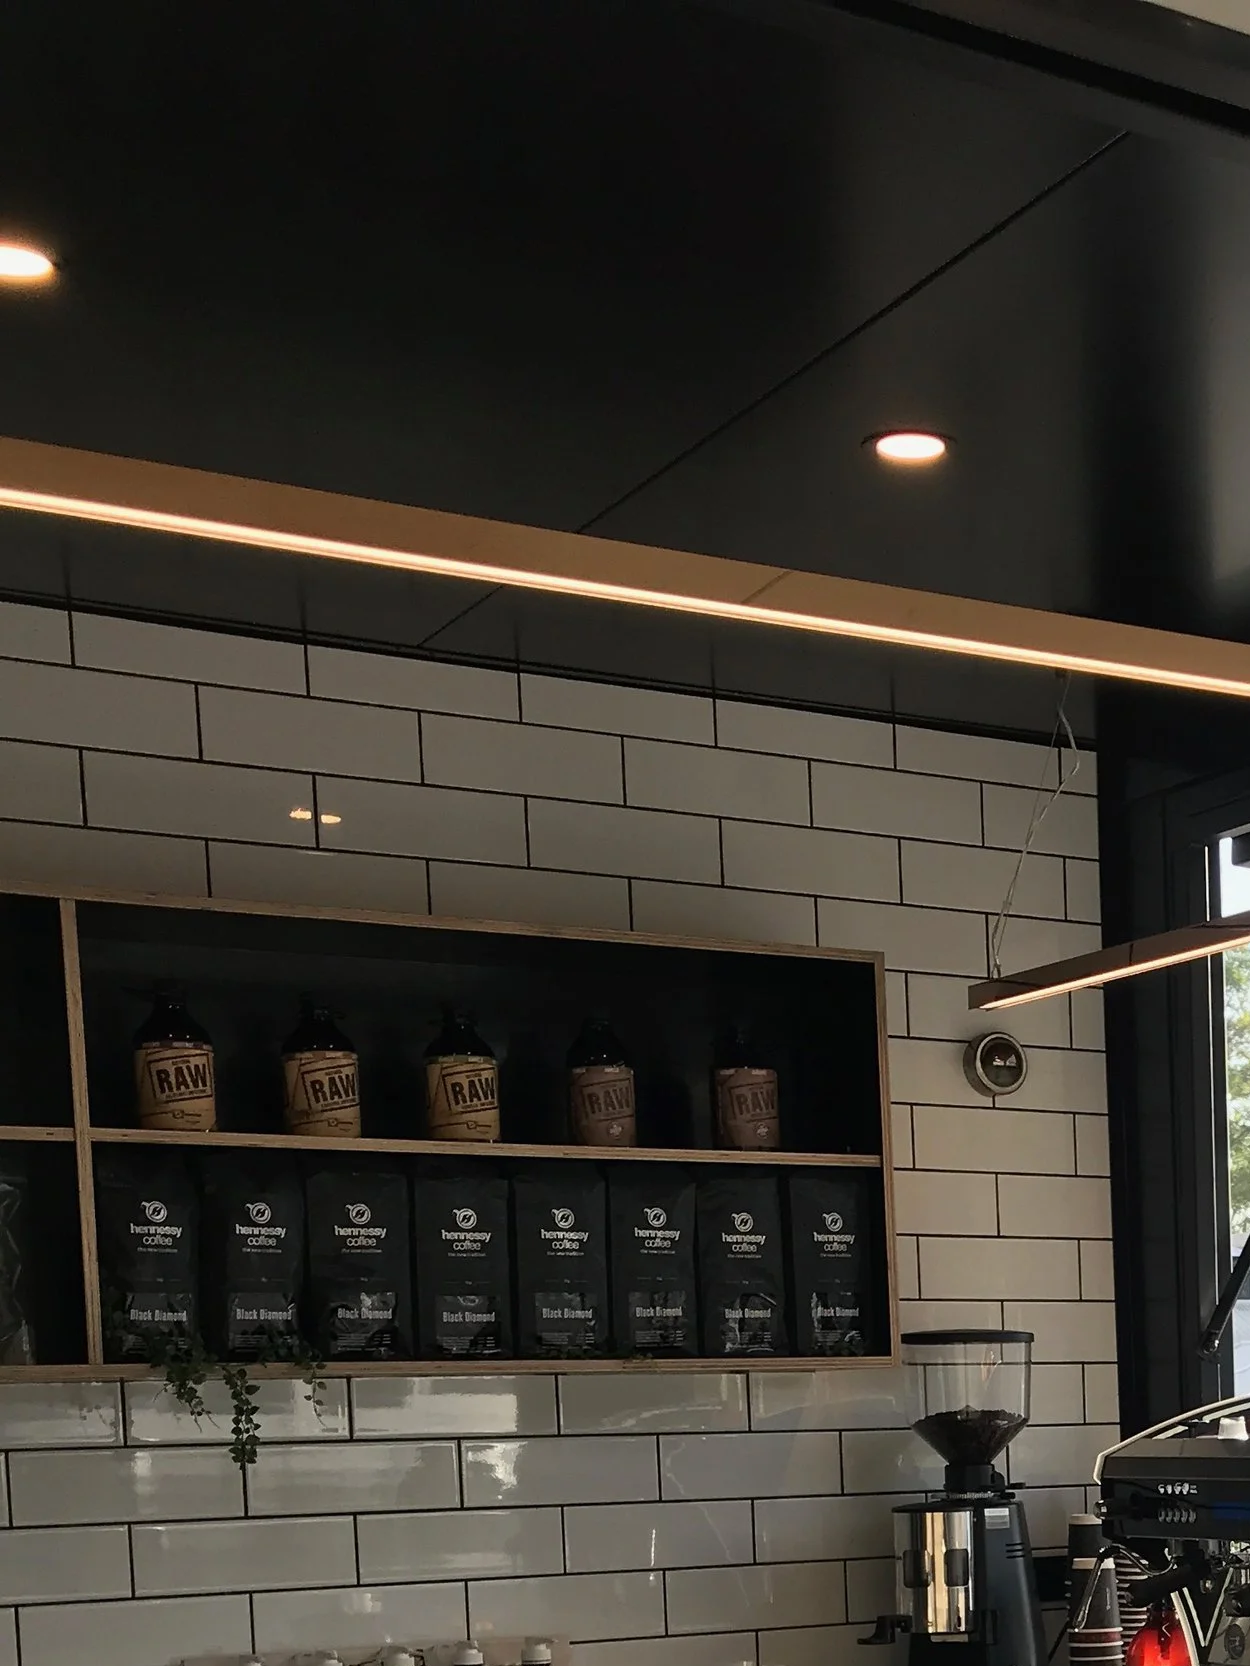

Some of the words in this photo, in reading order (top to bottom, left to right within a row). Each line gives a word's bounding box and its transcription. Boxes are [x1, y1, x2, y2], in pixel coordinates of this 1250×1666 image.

[156, 1064, 208, 1094] RAW
[310, 1073, 356, 1104] RAW
[451, 1076, 495, 1106] RAW
[587, 1086, 630, 1114] RAW
[735, 1088, 774, 1115] RAW
[130, 1223, 182, 1238] hennessy
[235, 1223, 286, 1239] hennessy
[334, 1225, 386, 1239] hennessy
[441, 1229, 491, 1243] hennessy
[540, 1228, 589, 1242] hennessy
[634, 1227, 680, 1241] hennessy
[142, 1235, 173, 1246] coffee
[247, 1236, 277, 1246] coffee
[346, 1236, 377, 1246] coffee
[645, 1238, 671, 1248] coffee
[722, 1233, 766, 1246] hennessy
[813, 1232, 855, 1245] hennessy
[453, 1240, 481, 1251] coffee
[552, 1240, 580, 1250] coffee
[732, 1243, 757, 1252] coffee
[823, 1242, 848, 1252] coffee
[130, 1309, 152, 1321] Black
[154, 1310, 187, 1321] Diamond
[236, 1309, 258, 1320] Black
[337, 1308, 359, 1319] Black
[442, 1312, 463, 1323] Black
[464, 1312, 496, 1323] Diamond
[542, 1308, 562, 1319] Black
[564, 1308, 593, 1319] Diamond
[635, 1307, 654, 1318] Black
[656, 1307, 682, 1317] Diamond
